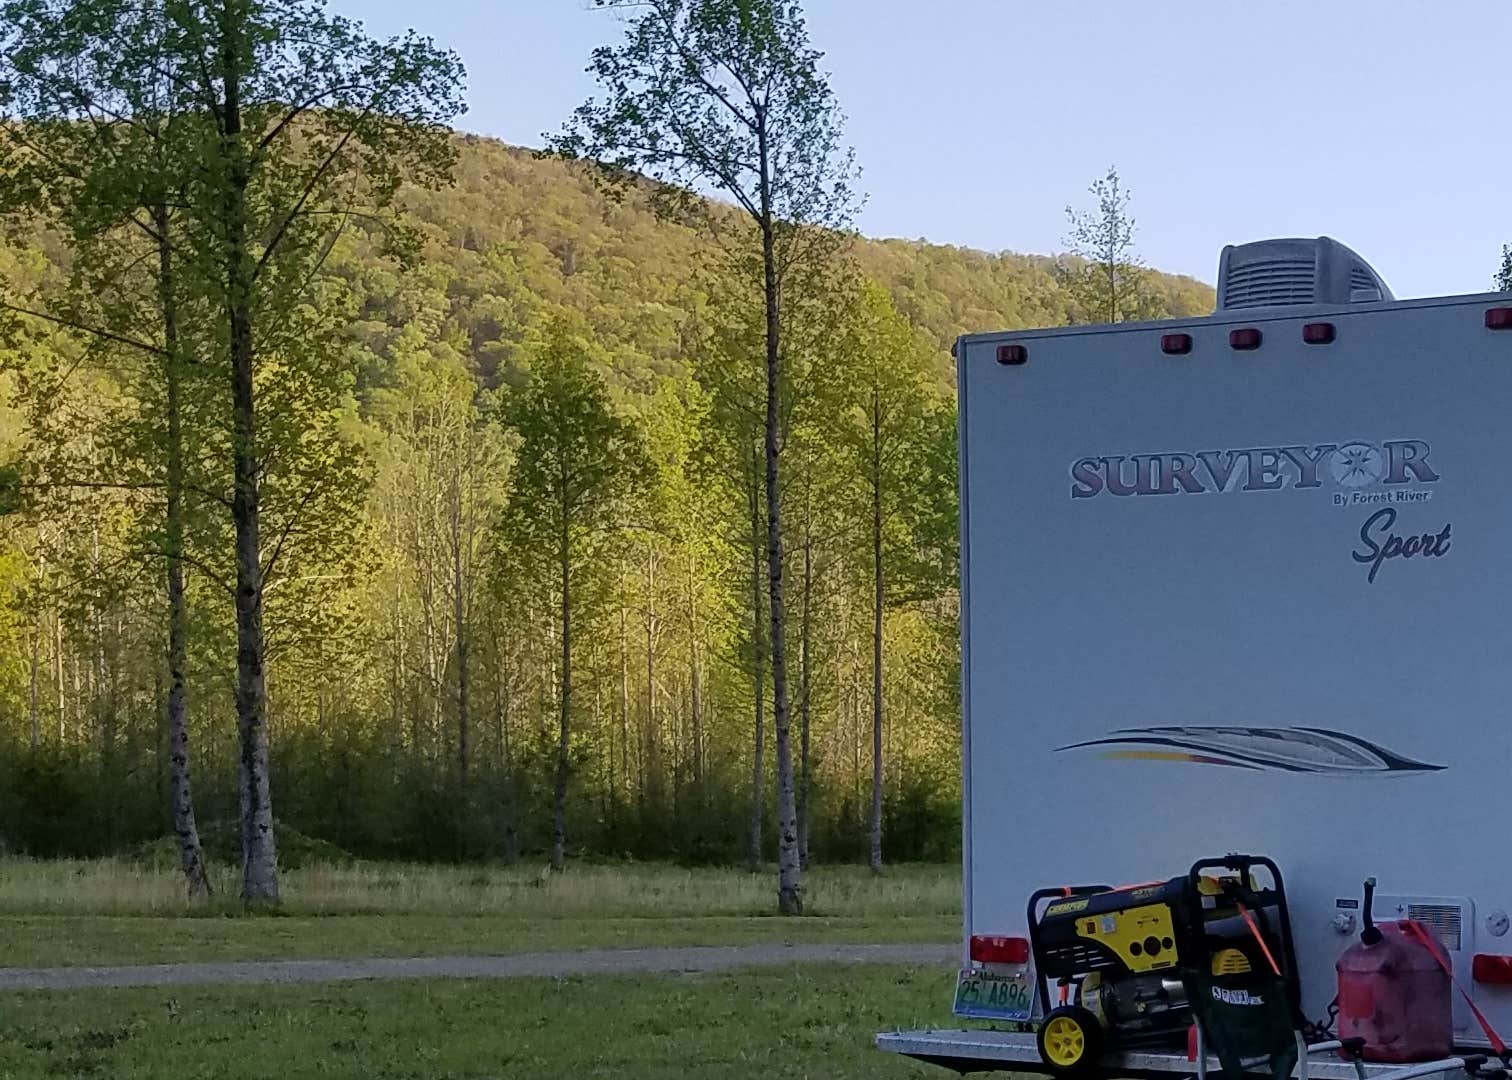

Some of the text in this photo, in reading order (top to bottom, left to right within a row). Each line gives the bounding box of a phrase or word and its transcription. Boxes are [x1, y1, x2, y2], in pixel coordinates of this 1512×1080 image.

[1071, 439, 1441, 499] SURVEYOR
[1333, 490, 1430, 507] By Forest River
[1352, 507, 1451, 584] Sport
